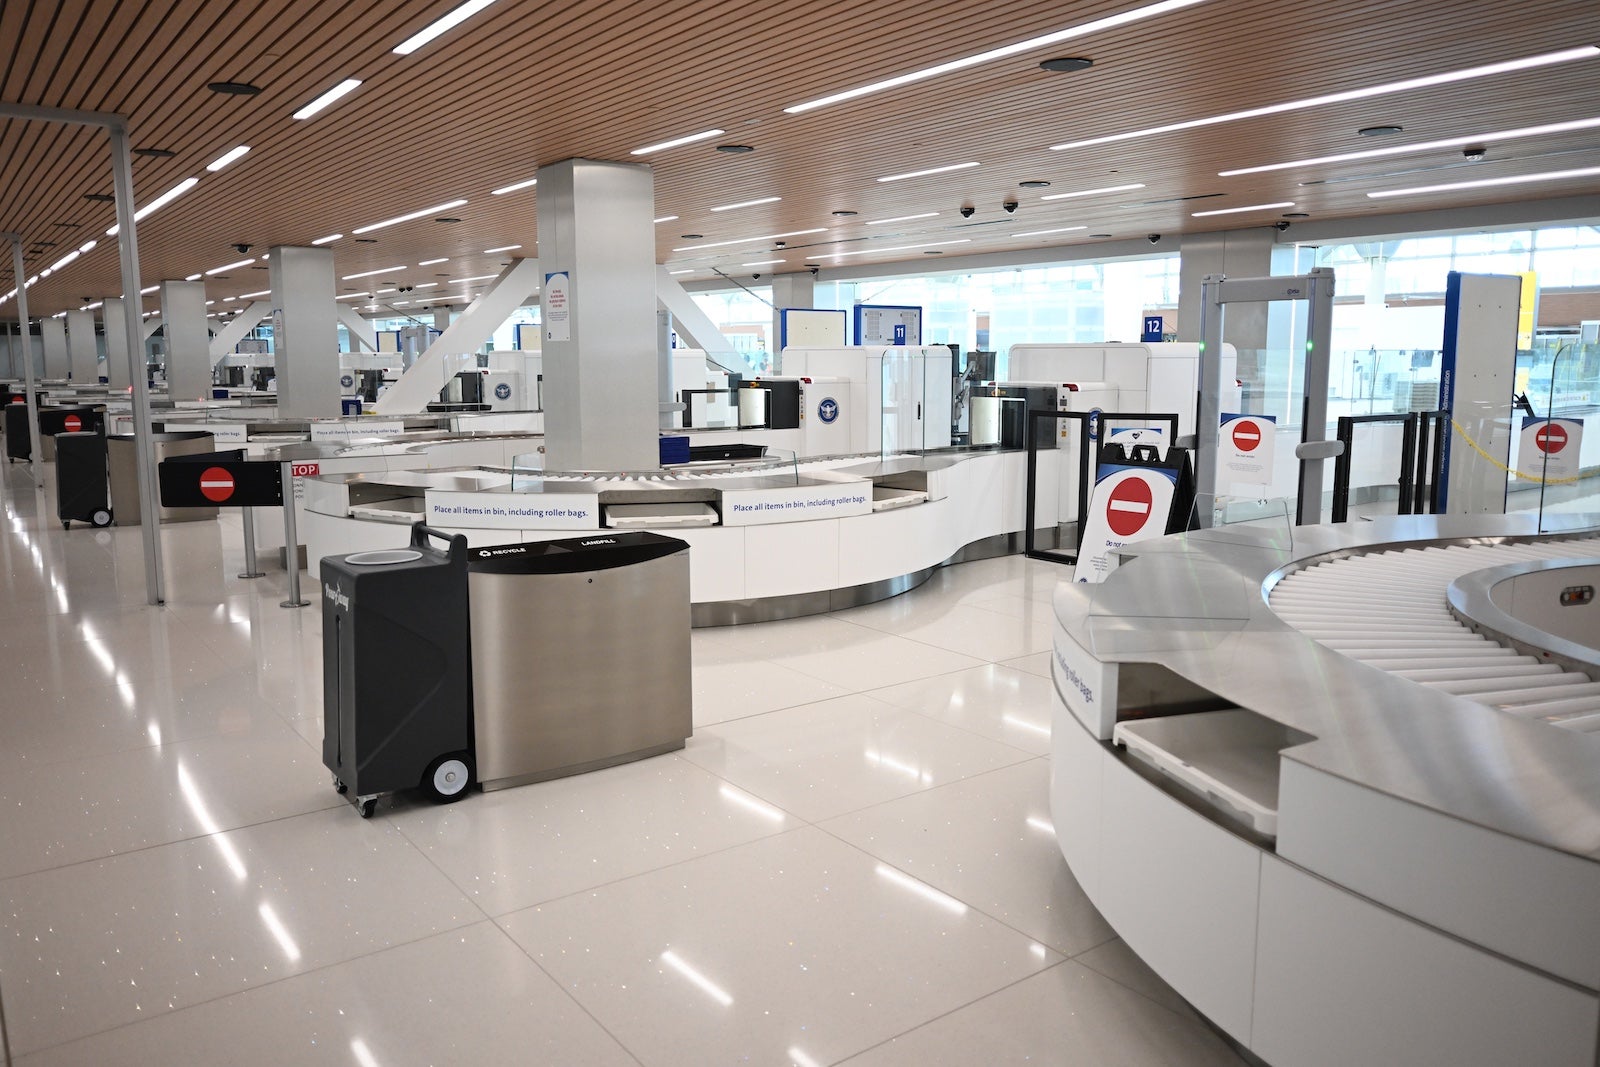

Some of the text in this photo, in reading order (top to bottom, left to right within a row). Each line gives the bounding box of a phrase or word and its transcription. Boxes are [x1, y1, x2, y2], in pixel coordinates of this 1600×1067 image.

[896, 327, 904, 338] 11
[1147, 320, 1160, 333] 12
[292, 465, 316, 476] TOP
[733, 504, 753, 512] Place
[754, 503, 764, 511] all
[764, 502, 784, 510] items
[785, 501, 792, 509] in
[793, 500, 806, 509] bin,
[807, 497, 836, 507] including
[836, 496, 851, 504] roller
[434, 505, 589, 519] Place all items in bin, including roller bags.
[493, 547, 527, 555] RECYCLE
